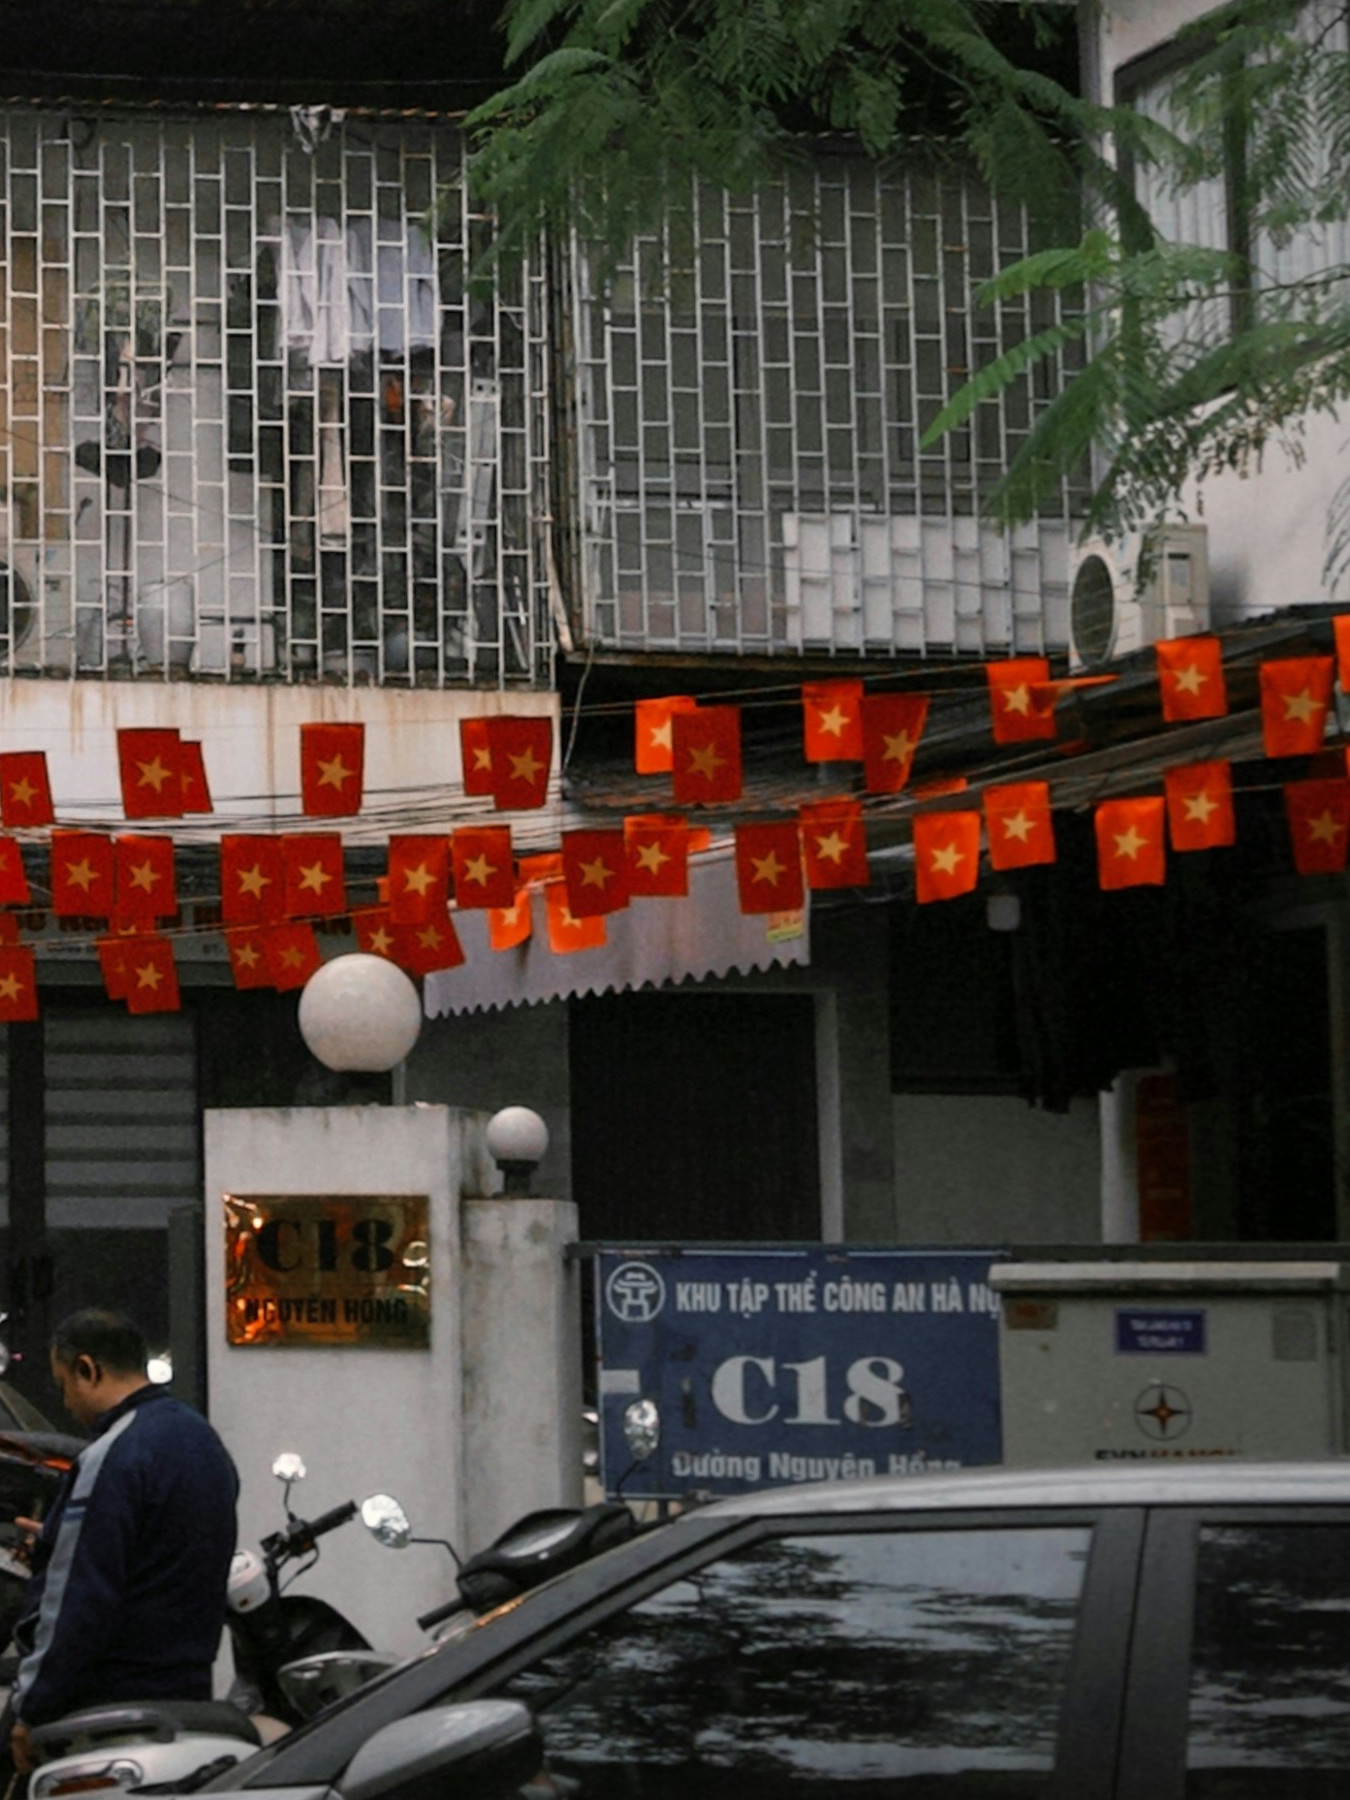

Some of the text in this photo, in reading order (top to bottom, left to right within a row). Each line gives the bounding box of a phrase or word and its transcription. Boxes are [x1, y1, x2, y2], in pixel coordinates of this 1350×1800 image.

[256, 1219, 394, 1273] C18
[675, 1281, 721, 1312] KHU
[726, 1277, 769, 1319] TẬP
[775, 1269, 816, 1312] THỂ
[822, 1275, 886, 1313] CÔNG
[892, 1281, 926, 1313] AN
[931, 1276, 963, 1313] HÀ
[711, 1354, 905, 1428] C18
[671, 1447, 761, 1481] Đường
